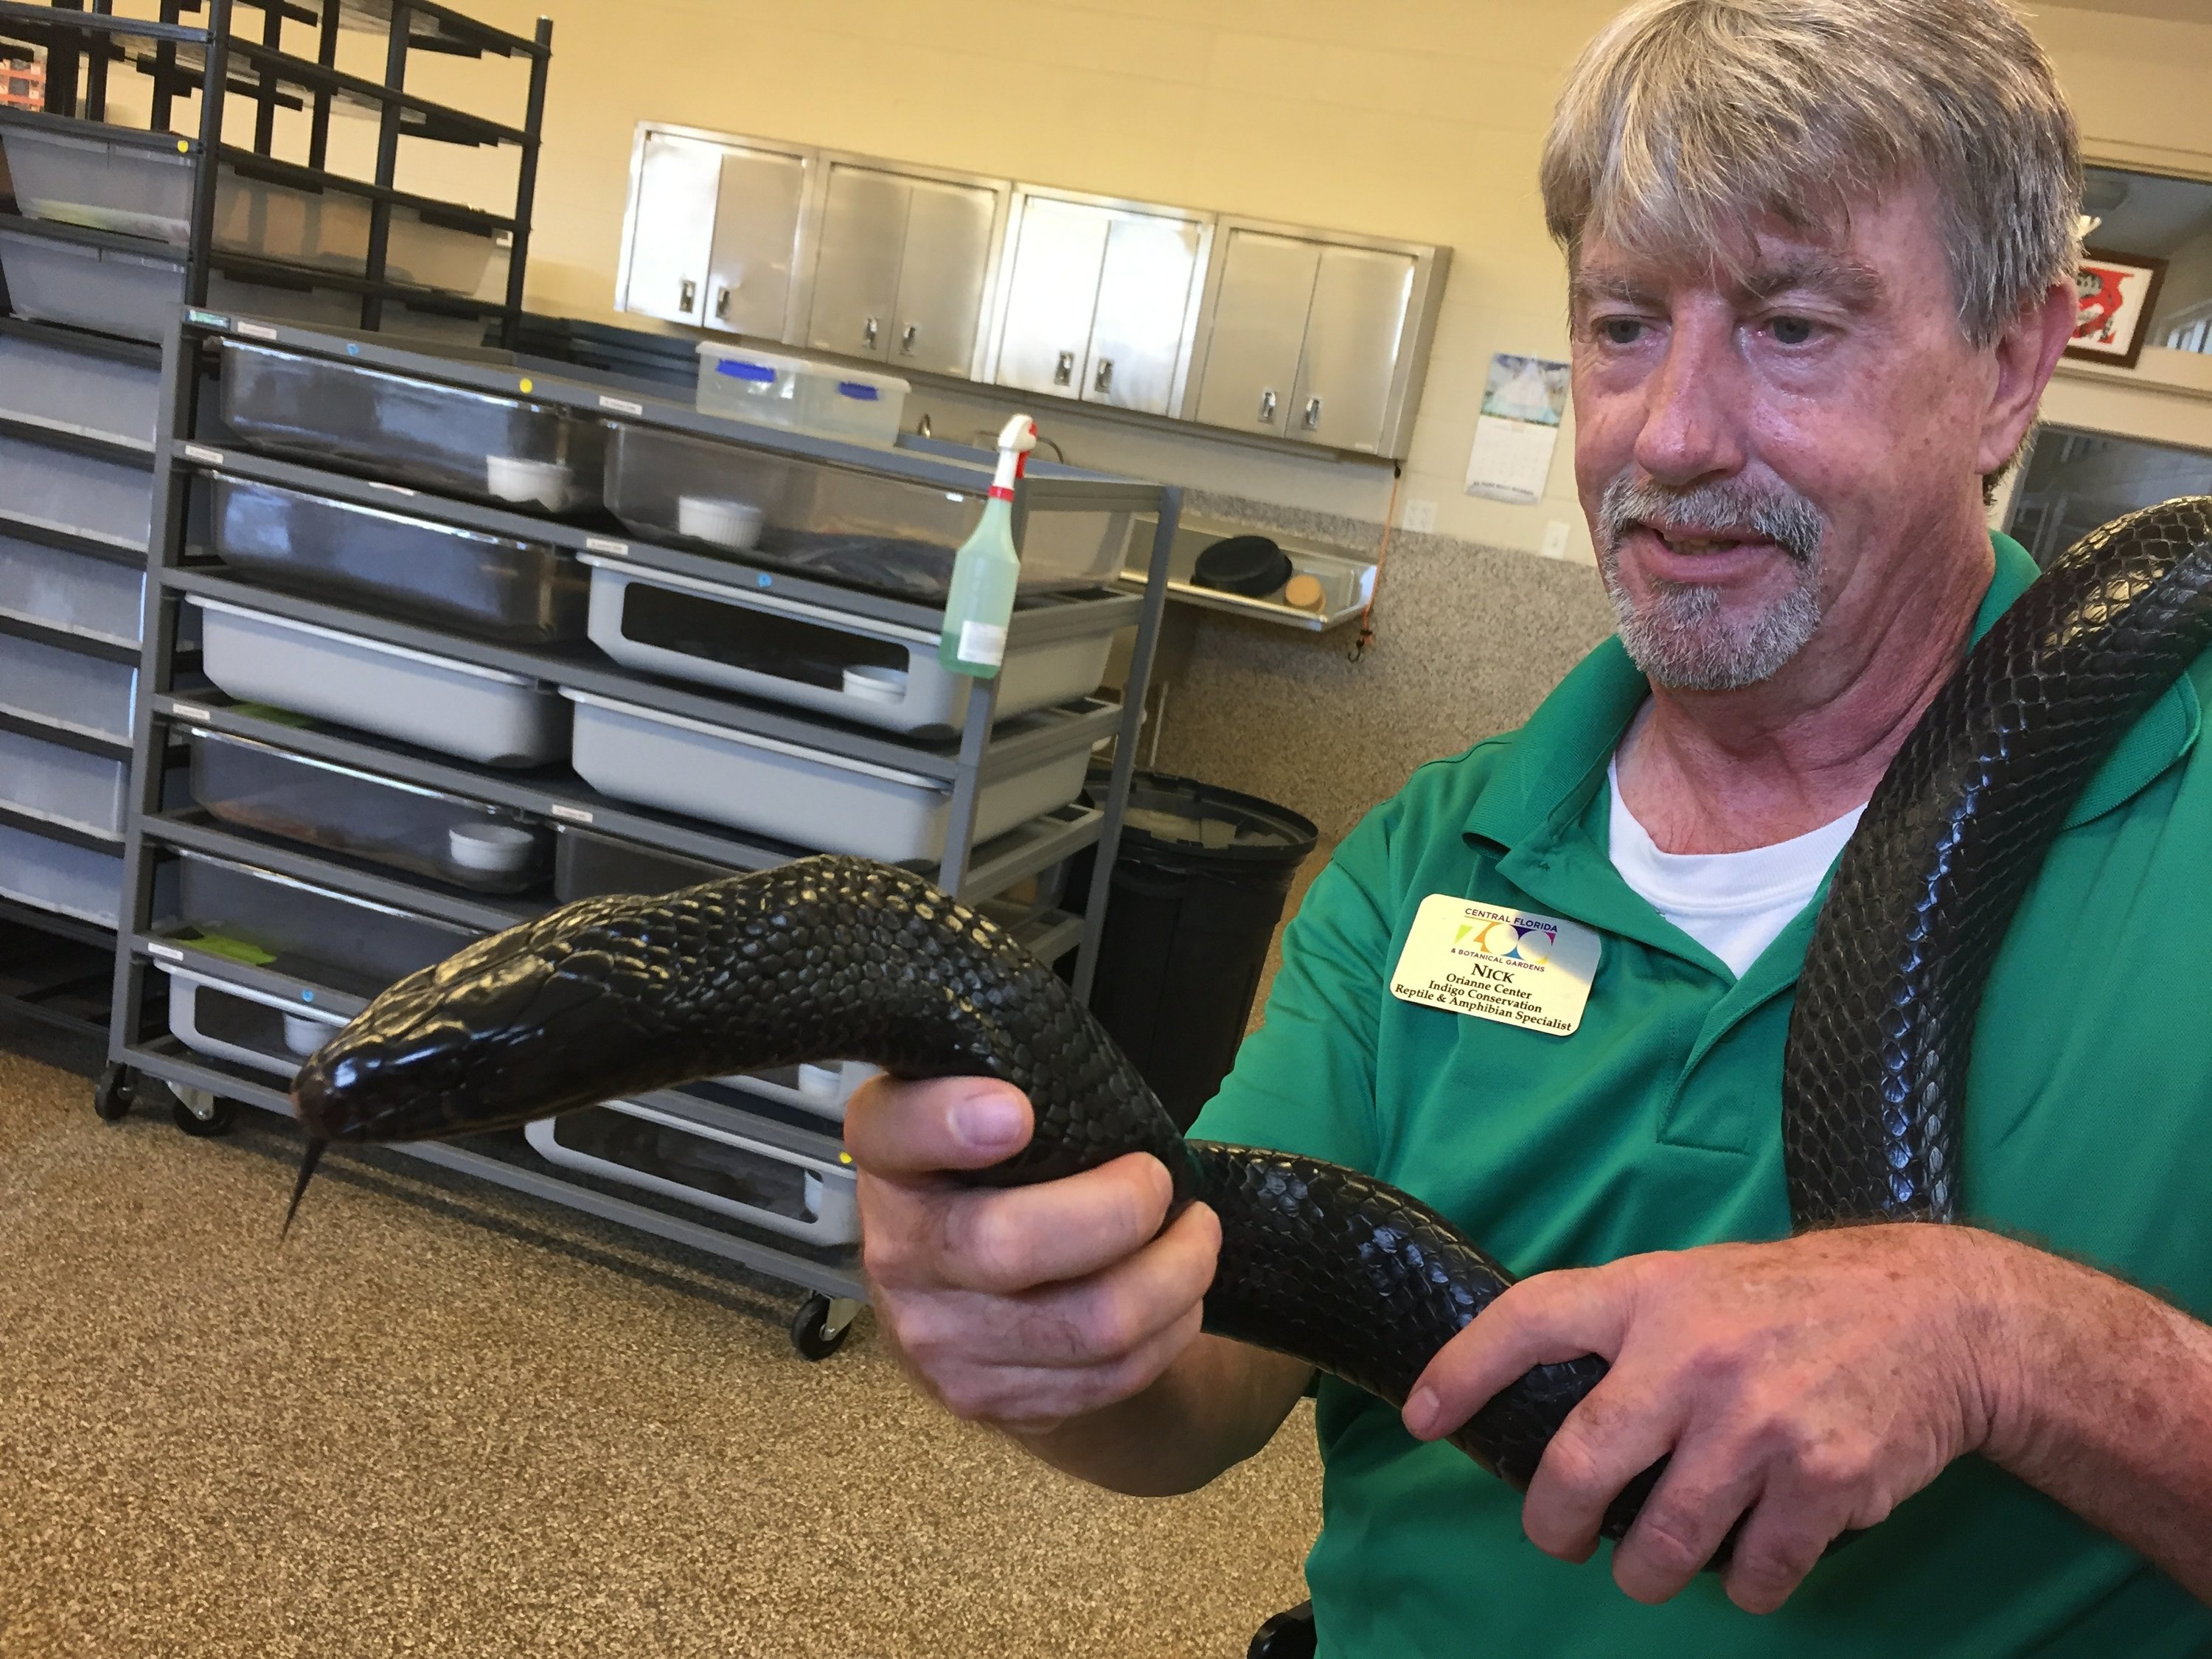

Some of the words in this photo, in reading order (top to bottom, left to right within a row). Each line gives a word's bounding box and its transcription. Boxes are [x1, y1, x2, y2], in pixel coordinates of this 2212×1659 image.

[1464, 908, 1512, 923] CENTRAL
[1514, 918, 1558, 933] FLORIDA
[1458, 948, 1503, 964] BOTANICAL
[1506, 959, 1545, 973] GARDENS
[1429, 981, 1465, 998] Indigo
[1467, 990, 1543, 1013] Conservation
[1446, 973, 1491, 991] Orianne
[1494, 984, 1532, 1000] Center
[1395, 984, 1434, 1002] Reptile
[1436, 994, 1447, 1003] &
[1450, 997, 1513, 1019] Amphibian
[1515, 1012, 1571, 1032] Specialist
